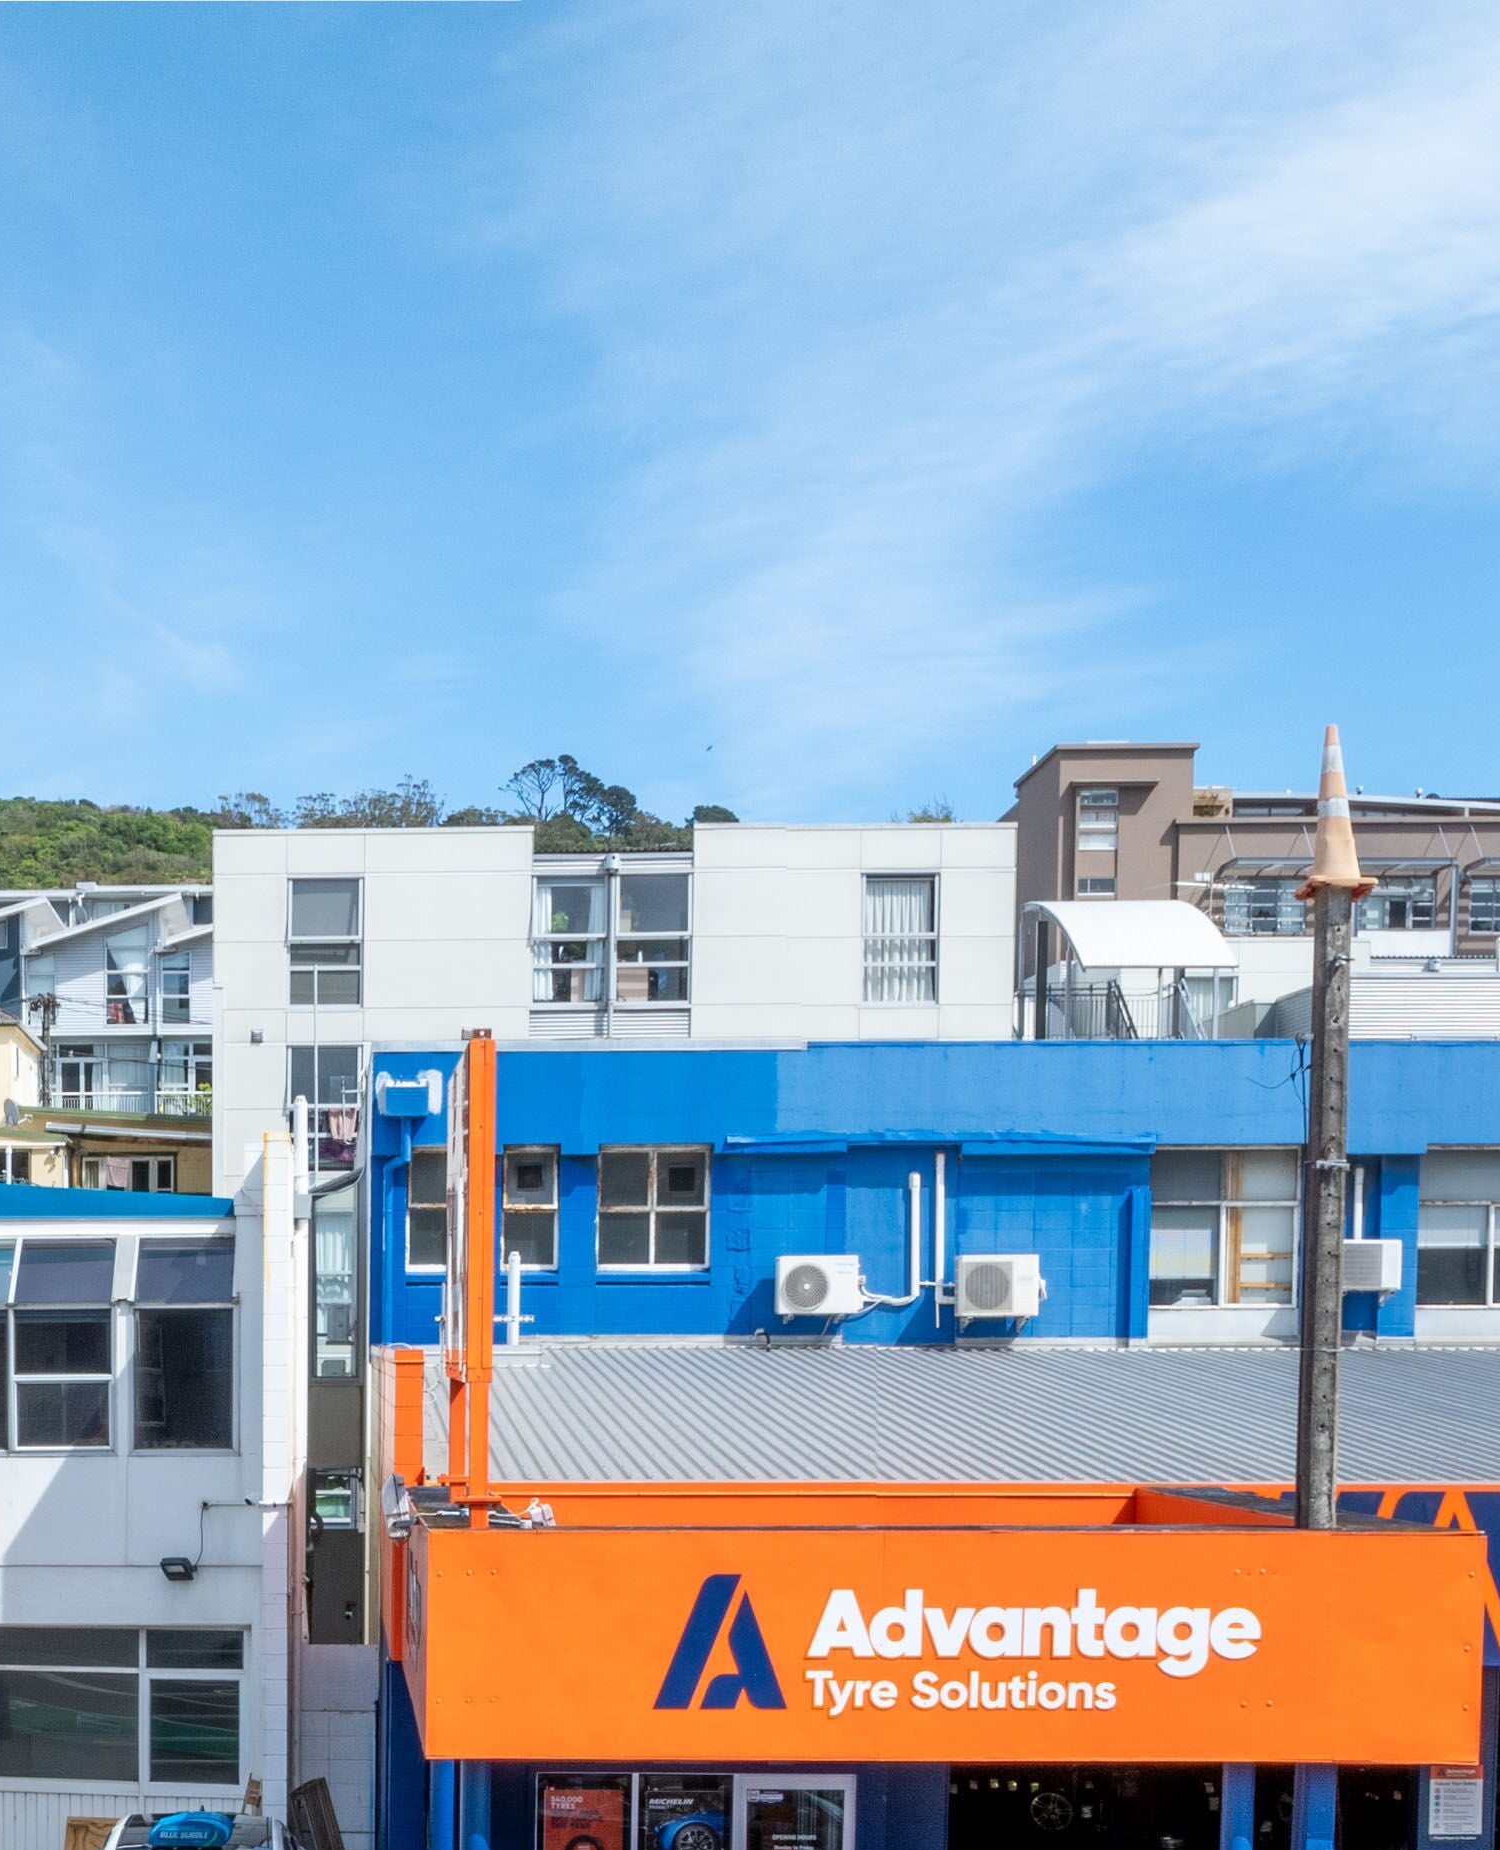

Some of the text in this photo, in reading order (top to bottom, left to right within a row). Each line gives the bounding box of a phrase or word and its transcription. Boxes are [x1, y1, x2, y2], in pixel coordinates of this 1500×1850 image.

[806, 1587, 1263, 1678] Advantage
[806, 1670, 1118, 1716] Tyre Solutions
[648, 1798, 694, 1806] MICHELIN
